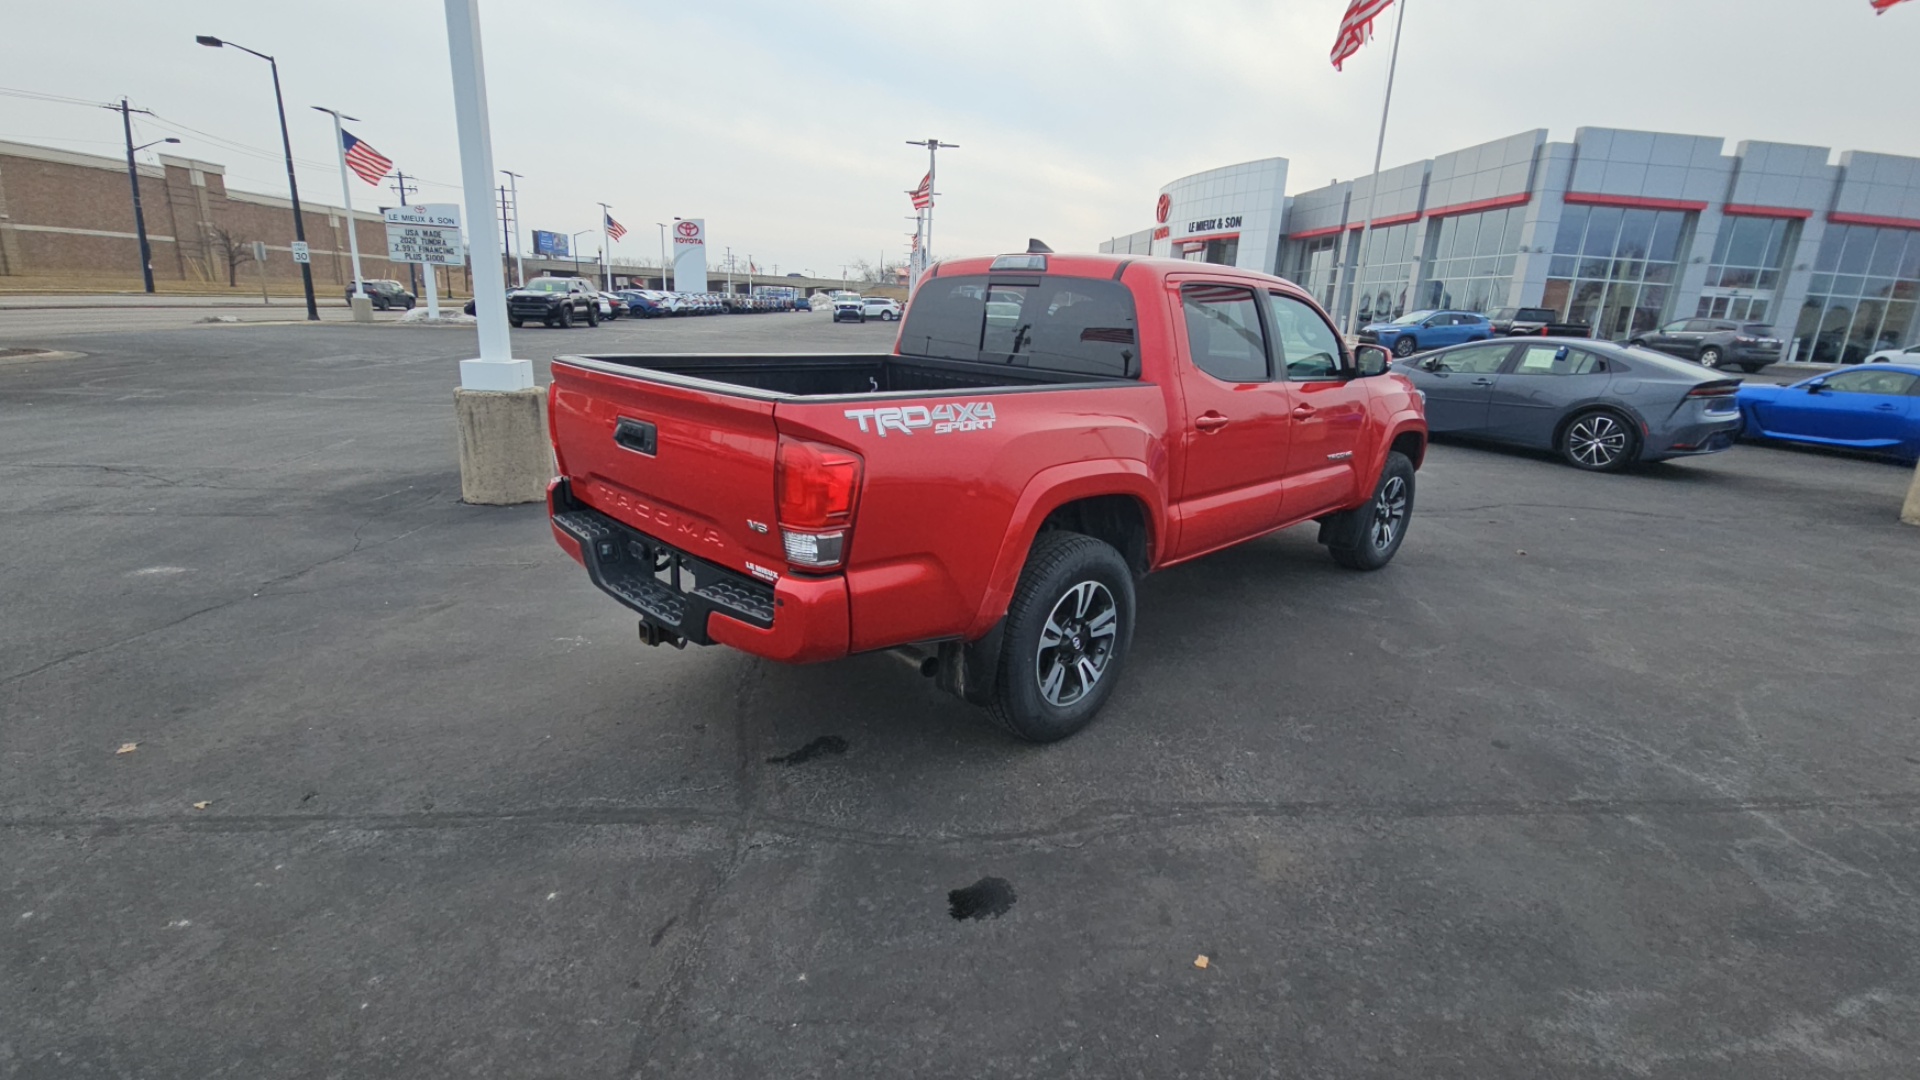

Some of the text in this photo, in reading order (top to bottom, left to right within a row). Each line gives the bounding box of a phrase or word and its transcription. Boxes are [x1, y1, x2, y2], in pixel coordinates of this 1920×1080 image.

[1188, 216, 1242, 232] LE MIEUX & SON
[422, 230, 442, 238] MADE
[420, 238, 447, 246] TUNDRA
[295, 252, 308, 260] 30
[418, 246, 454, 254] FINANCING
[844, 406, 933, 438] TRD
[934, 418, 996, 434] SPORT
[599, 485, 724, 547] TACOMA
[746, 519, 768, 534] V6
